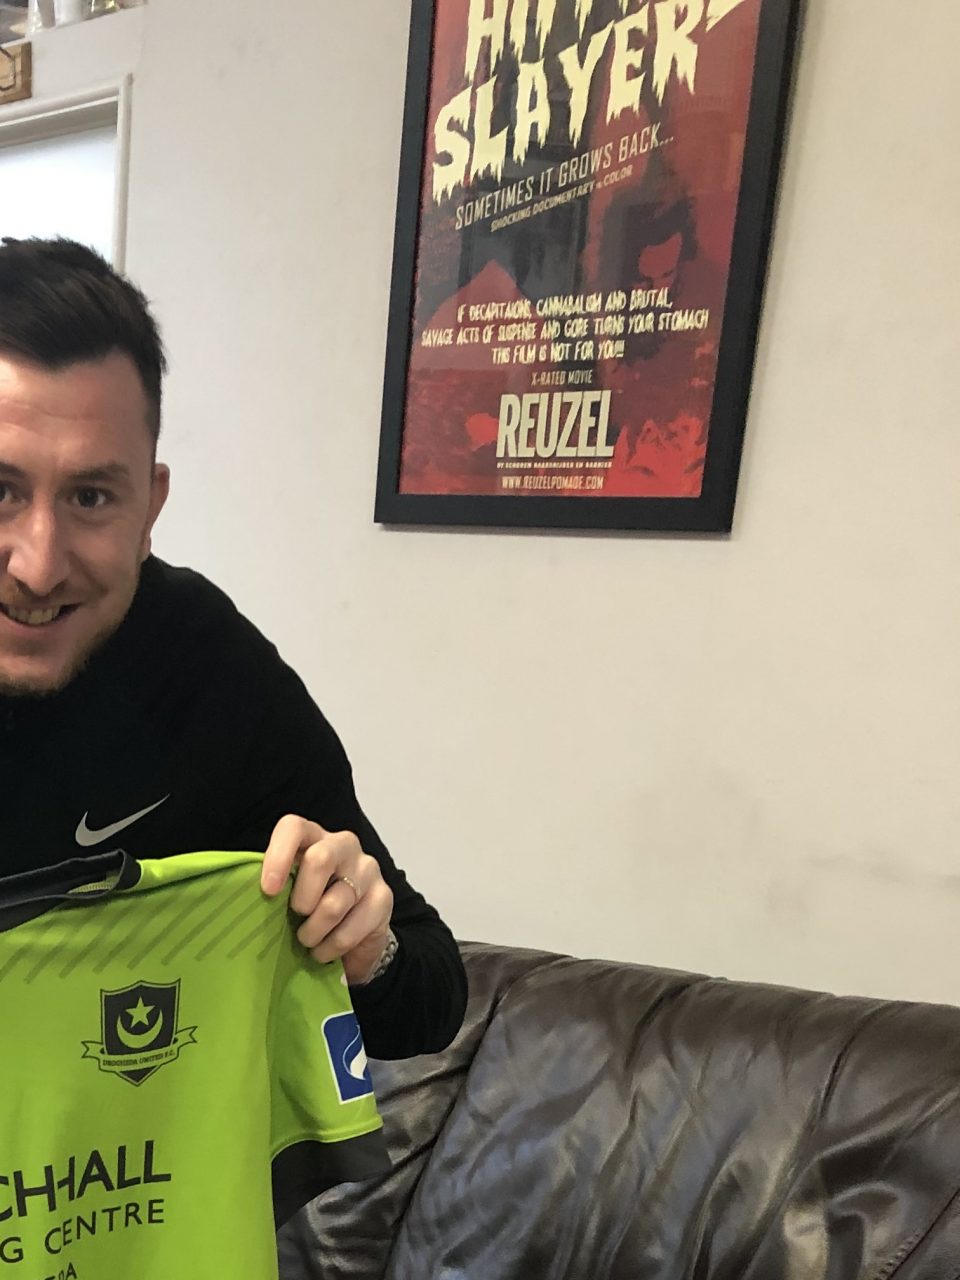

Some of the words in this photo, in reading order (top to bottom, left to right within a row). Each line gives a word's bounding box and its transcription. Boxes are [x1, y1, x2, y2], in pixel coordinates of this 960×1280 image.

[432, 0, 704, 205] SLAYER
[455, 176, 534, 230] SOMETIMES
[539, 167, 554, 196] IT
[558, 142, 614, 187] GROWS
[618, 121, 674, 163] BACK...
[490, 206, 532, 232] SHOCKING
[532, 181, 596, 215] DOCUMENTARY
[603, 165, 634, 186] COLOR
[605, 290, 627, 312] AND
[421, 328, 454, 347] SAVAGE
[456, 327, 480, 346] ACTS
[482, 324, 496, 344] OF
[540, 319, 561, 340] AND
[564, 317, 589, 338] GORE
[628, 311, 655, 334] YOUR
[513, 343, 537, 364] FILM
[539, 344, 548, 362] IS
[550, 342, 572, 363] NOT
[574, 340, 594, 361] FOR
[531, 370, 565, 386] X-RATED
[567, 369, 593, 384] MOVIE
[495, 390, 614, 458] REUZEL
[501, 475, 604, 490] WWW.REUZELPOMADE.COM
[44, 1198, 165, 1255] CENTRE
